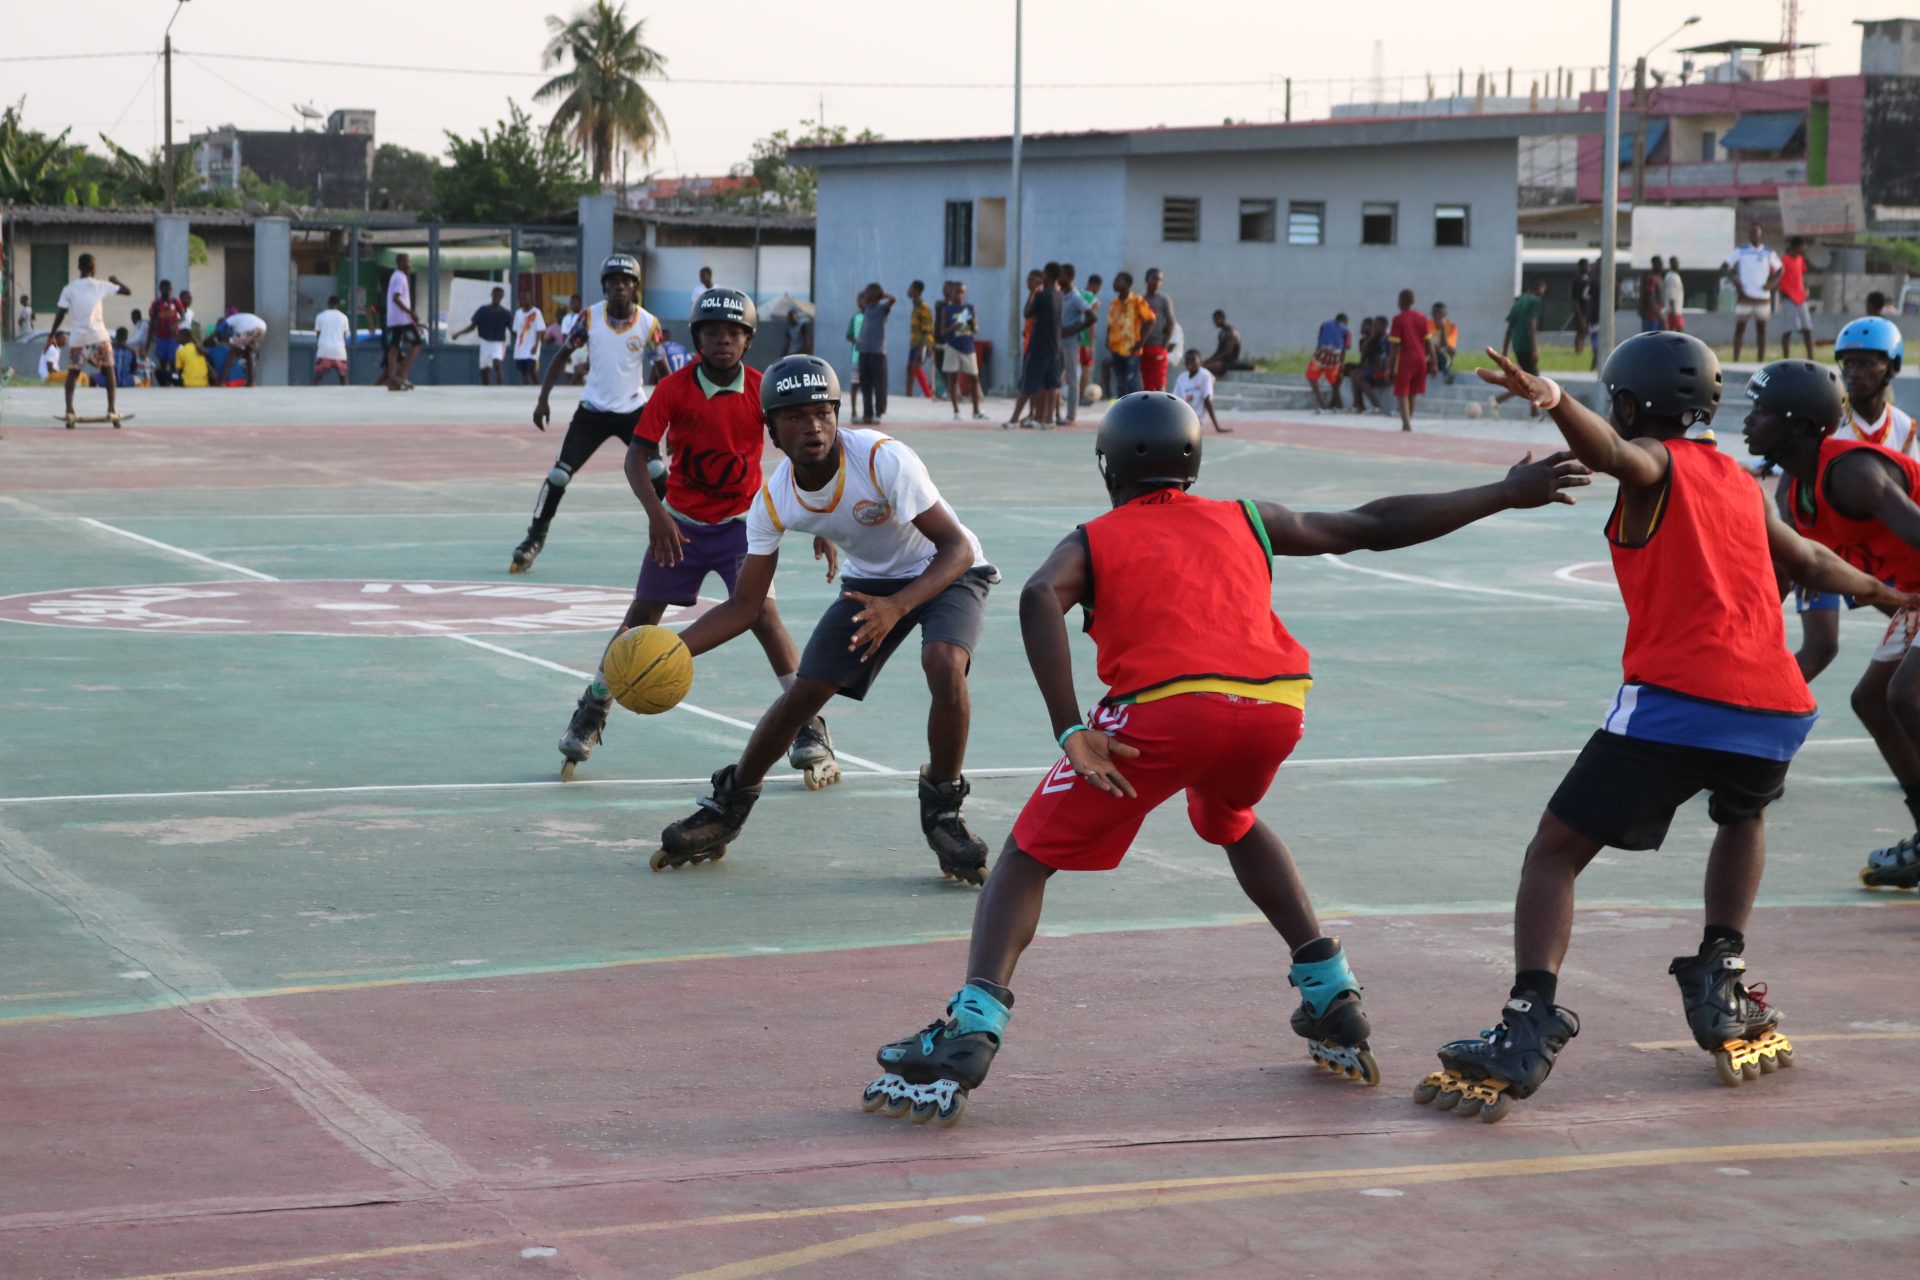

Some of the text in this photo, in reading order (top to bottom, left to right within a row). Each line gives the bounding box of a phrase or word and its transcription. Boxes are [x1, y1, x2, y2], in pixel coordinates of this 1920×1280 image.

[701, 297, 744, 310] ROLL BALL
[776, 373, 828, 392] ROLL BALL
